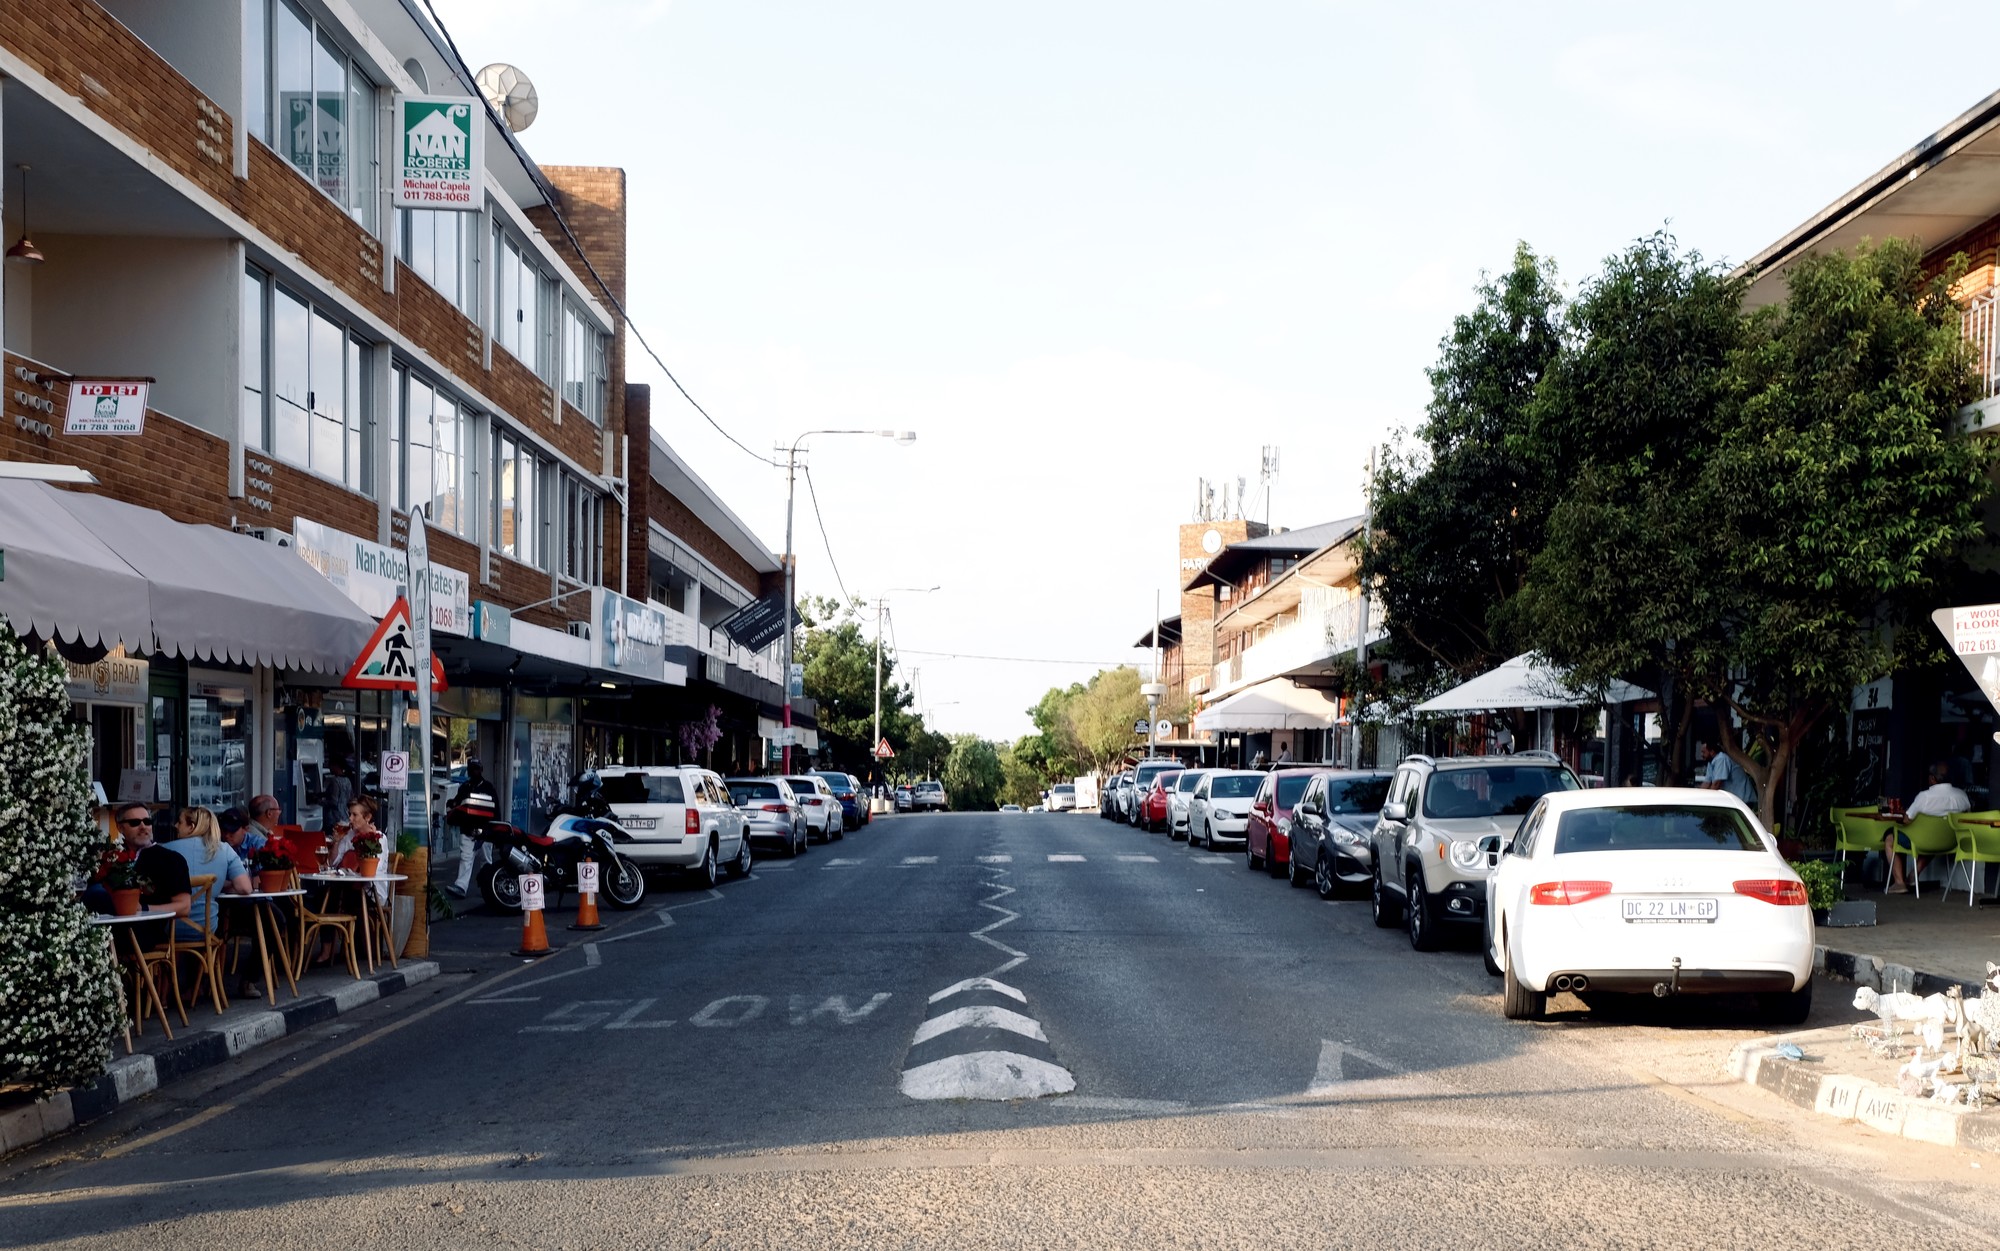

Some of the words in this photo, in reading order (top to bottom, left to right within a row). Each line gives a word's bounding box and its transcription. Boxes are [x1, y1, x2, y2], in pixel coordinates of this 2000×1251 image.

[408, 133, 466, 158] NAN
[407, 156, 466, 169] ROBERTS
[404, 169, 470, 180] ESTATES
[403, 179, 438, 190] Michael
[439, 181, 471, 192] Capela
[403, 190, 421, 200] 011
[422, 191, 470, 202] 788-1068
[86, 386, 104, 396] TO
[110, 386, 135, 396] LET
[71, 423, 87, 431] 011
[90, 423, 108, 431] 788
[113, 423, 136, 431] 1068
[355, 543, 377, 574] Nan
[435, 605, 453, 628] 1068
[1958, 640, 1976, 653] 072
[1979, 639, 1996, 651] 613
[112, 662, 140, 685] BRAZA
[1867, 687, 1879, 708] 34
[1627, 902, 1642, 916] DC
[1649, 902, 1664, 916] 22
[1670, 902, 1686, 916] LN
[1697, 902, 1713, 916] GP
[517, 991, 893, 1035] SLOW
[1865, 1098, 1897, 1121] AVE
